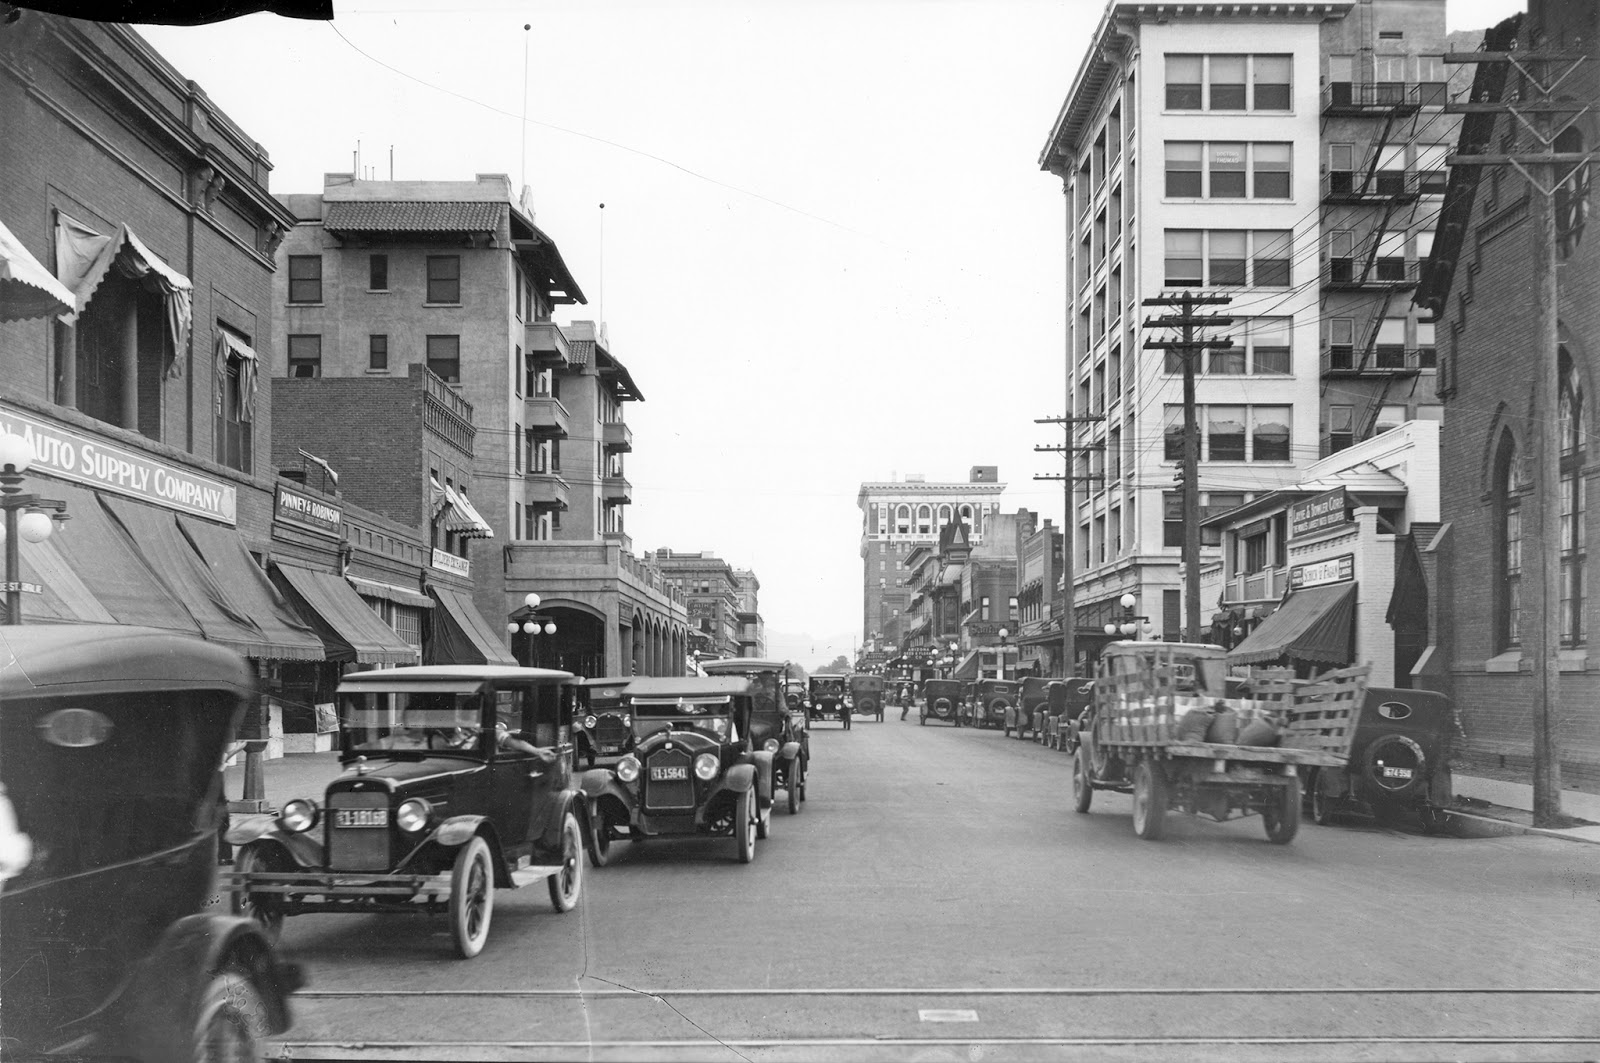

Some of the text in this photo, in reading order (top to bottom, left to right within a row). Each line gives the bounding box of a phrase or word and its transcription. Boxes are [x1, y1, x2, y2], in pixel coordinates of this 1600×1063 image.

[24, 424, 221, 512] AUTO SUPPLY COMPANY
[280, 491, 307, 513] PINNEY
[306, 500, 311, 515] &
[311, 502, 340, 525] ROBINSON
